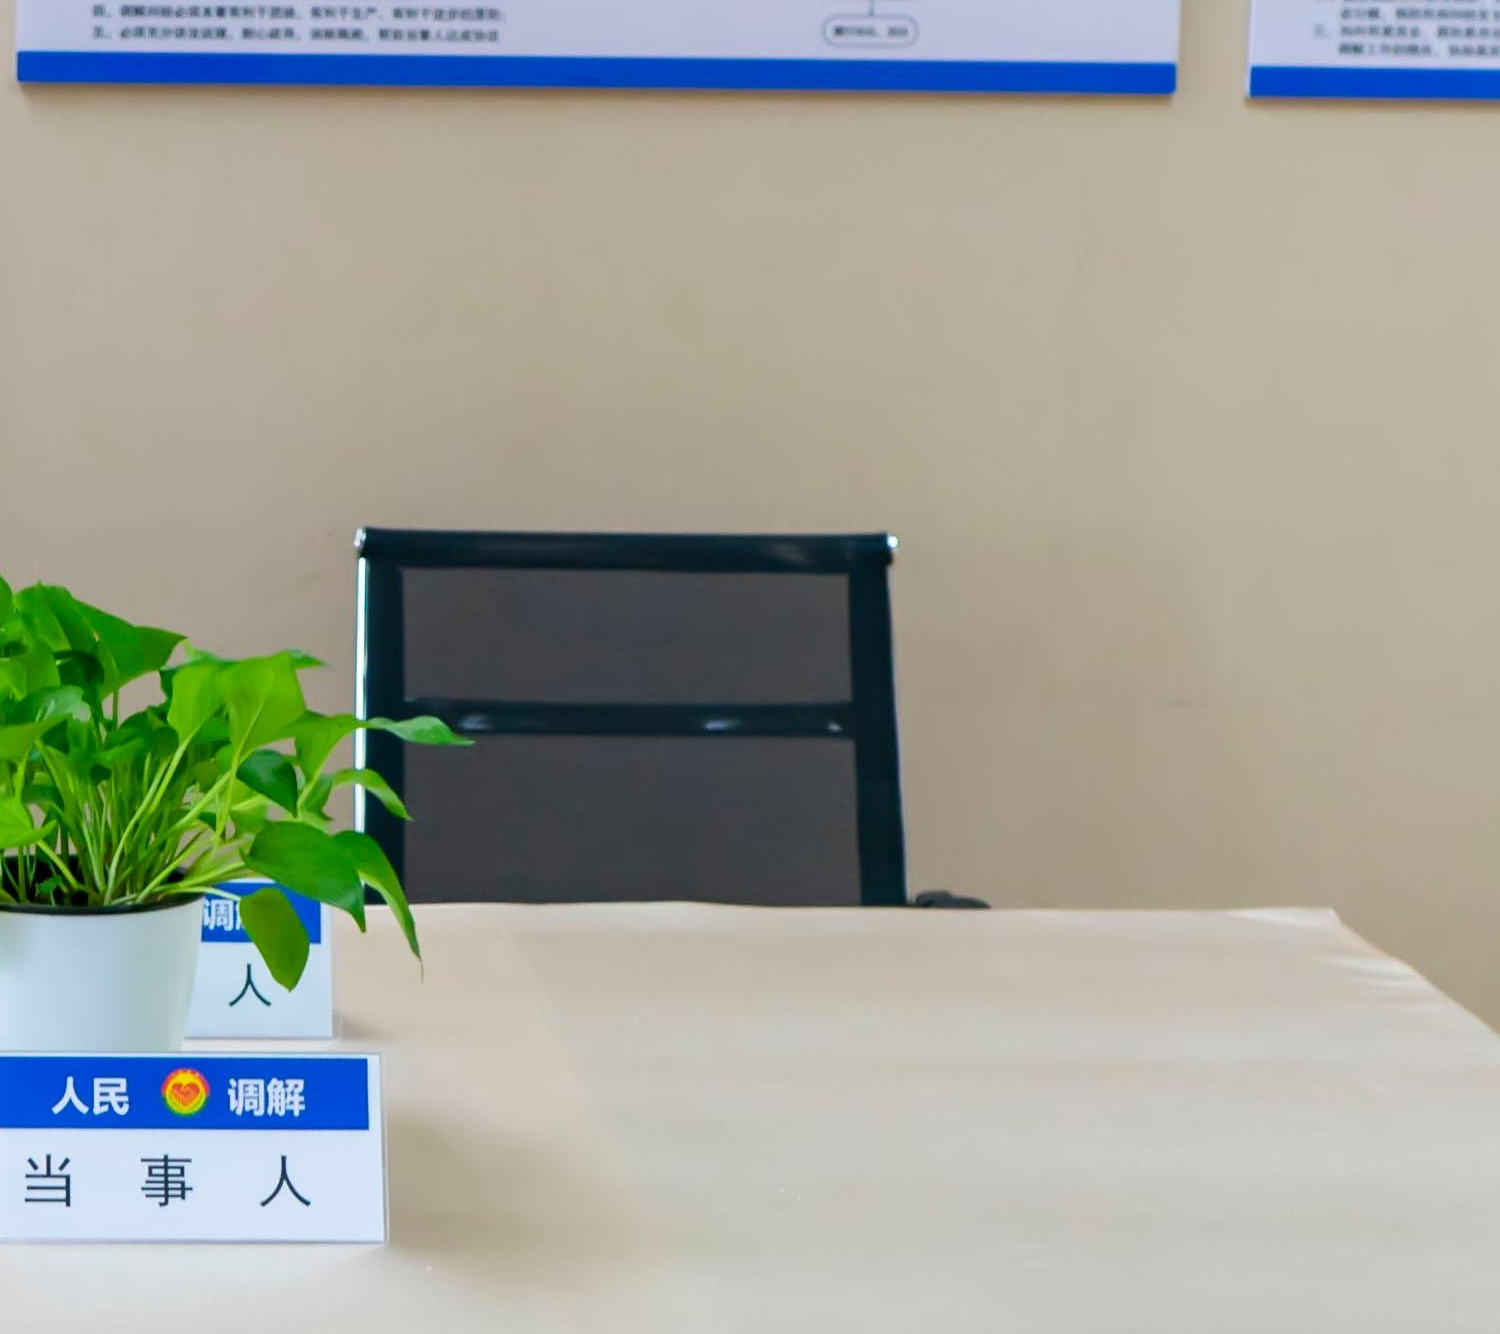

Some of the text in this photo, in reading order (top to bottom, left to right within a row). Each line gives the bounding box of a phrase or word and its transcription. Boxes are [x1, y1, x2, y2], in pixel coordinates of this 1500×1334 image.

[51, 1075, 307, 1118] 人民 调解
[24, 1153, 312, 1209] 当事人
